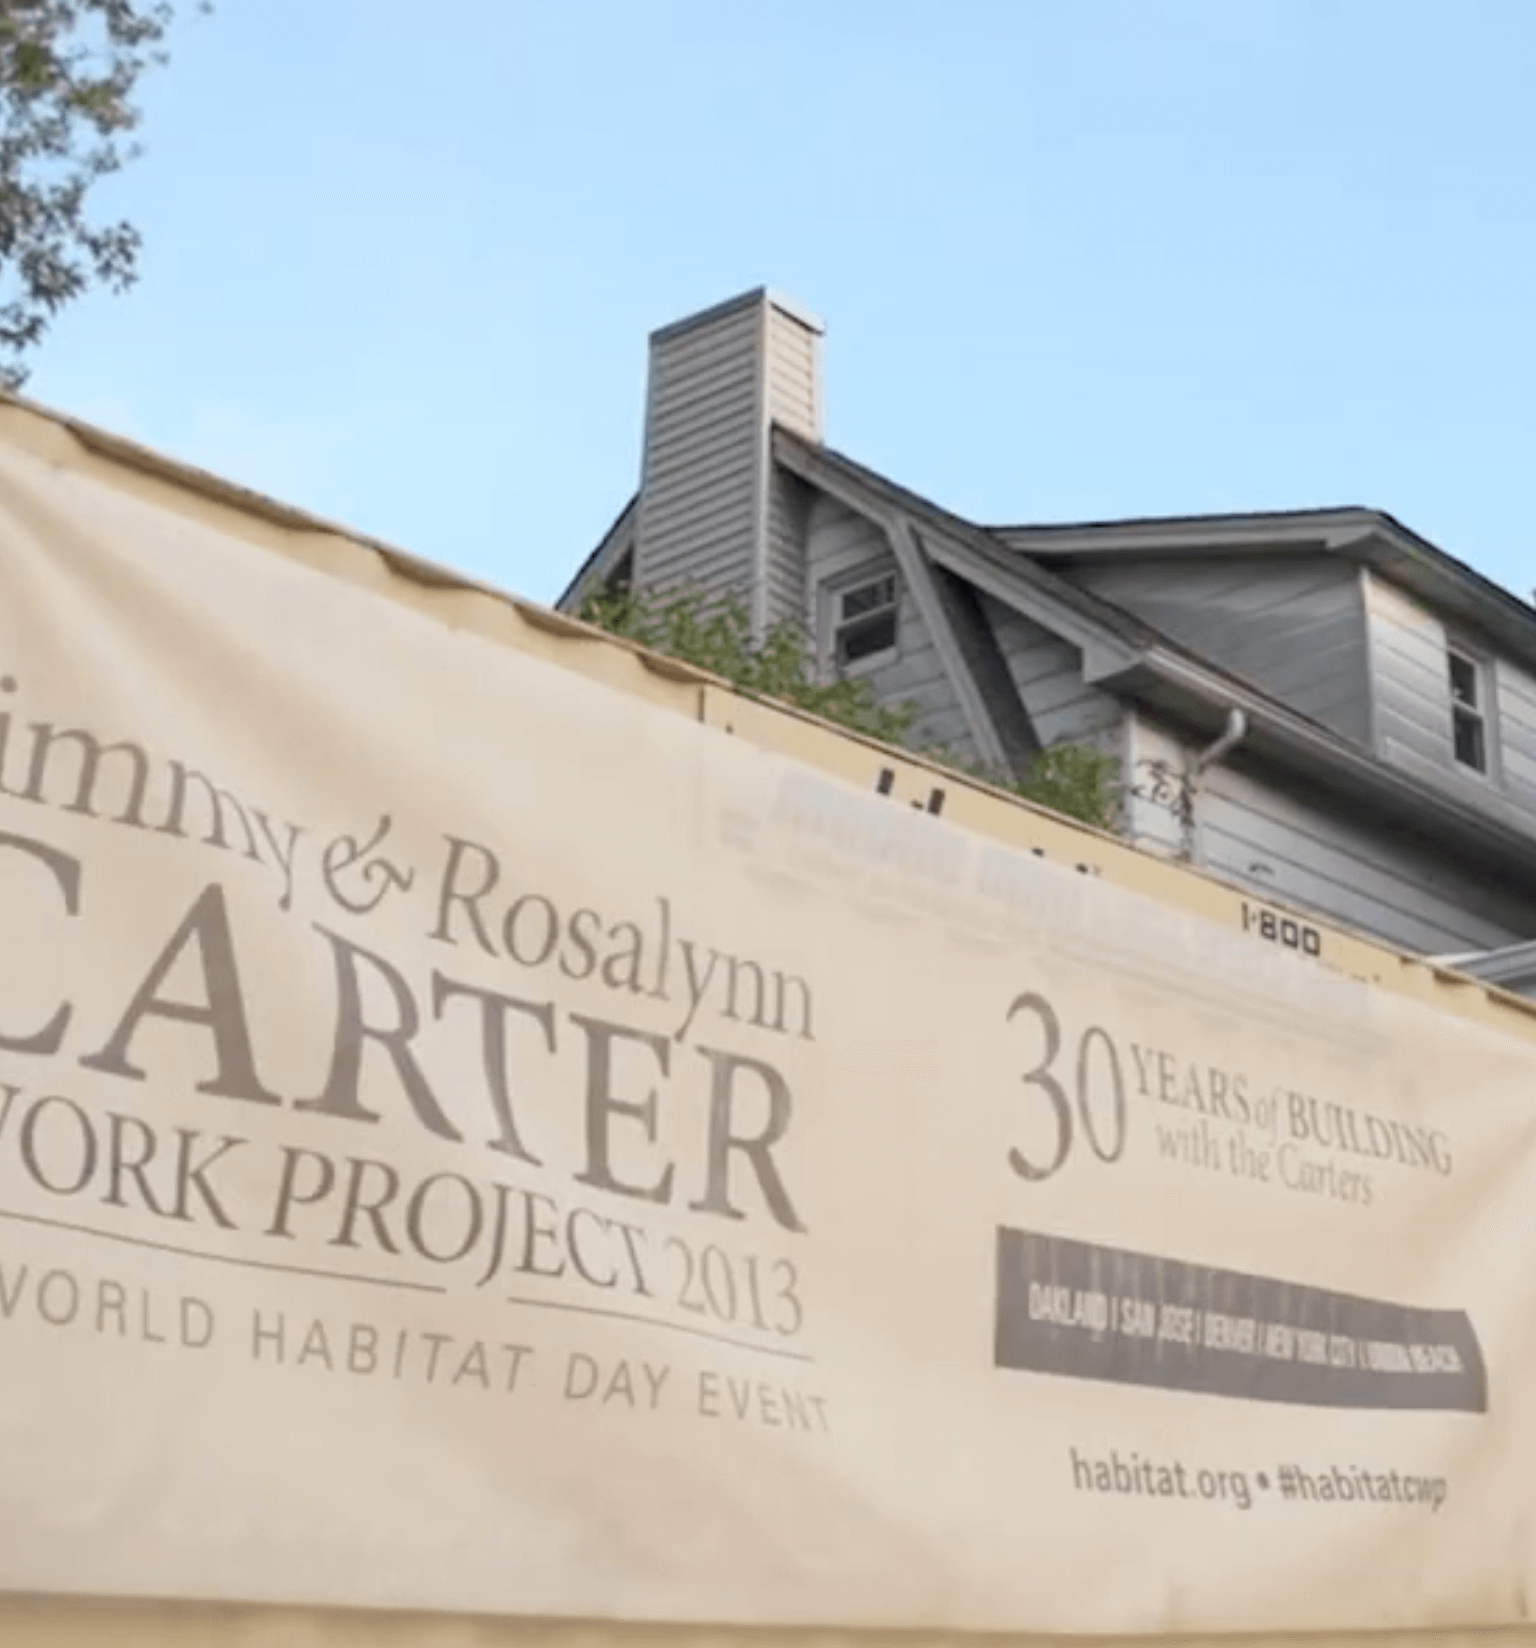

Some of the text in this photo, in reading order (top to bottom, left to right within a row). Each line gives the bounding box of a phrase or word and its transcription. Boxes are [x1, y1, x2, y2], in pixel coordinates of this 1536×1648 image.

[323, 814, 415, 914] &
[426, 833, 816, 1043] Rosalynn
[1005, 991, 1453, 1182] 30 YEARS of BUILDING
[1155, 1119, 1373, 1206] with the Carters
[0, 1083, 803, 1337] ORK PROJECT 2013
[250, 1309, 535, 1395] HABITAT
[562, 1352, 671, 1410] DAY
[697, 1369, 831, 1434] EVENT
[1070, 1446, 1448, 1513] habitat.org #habitatcwp
